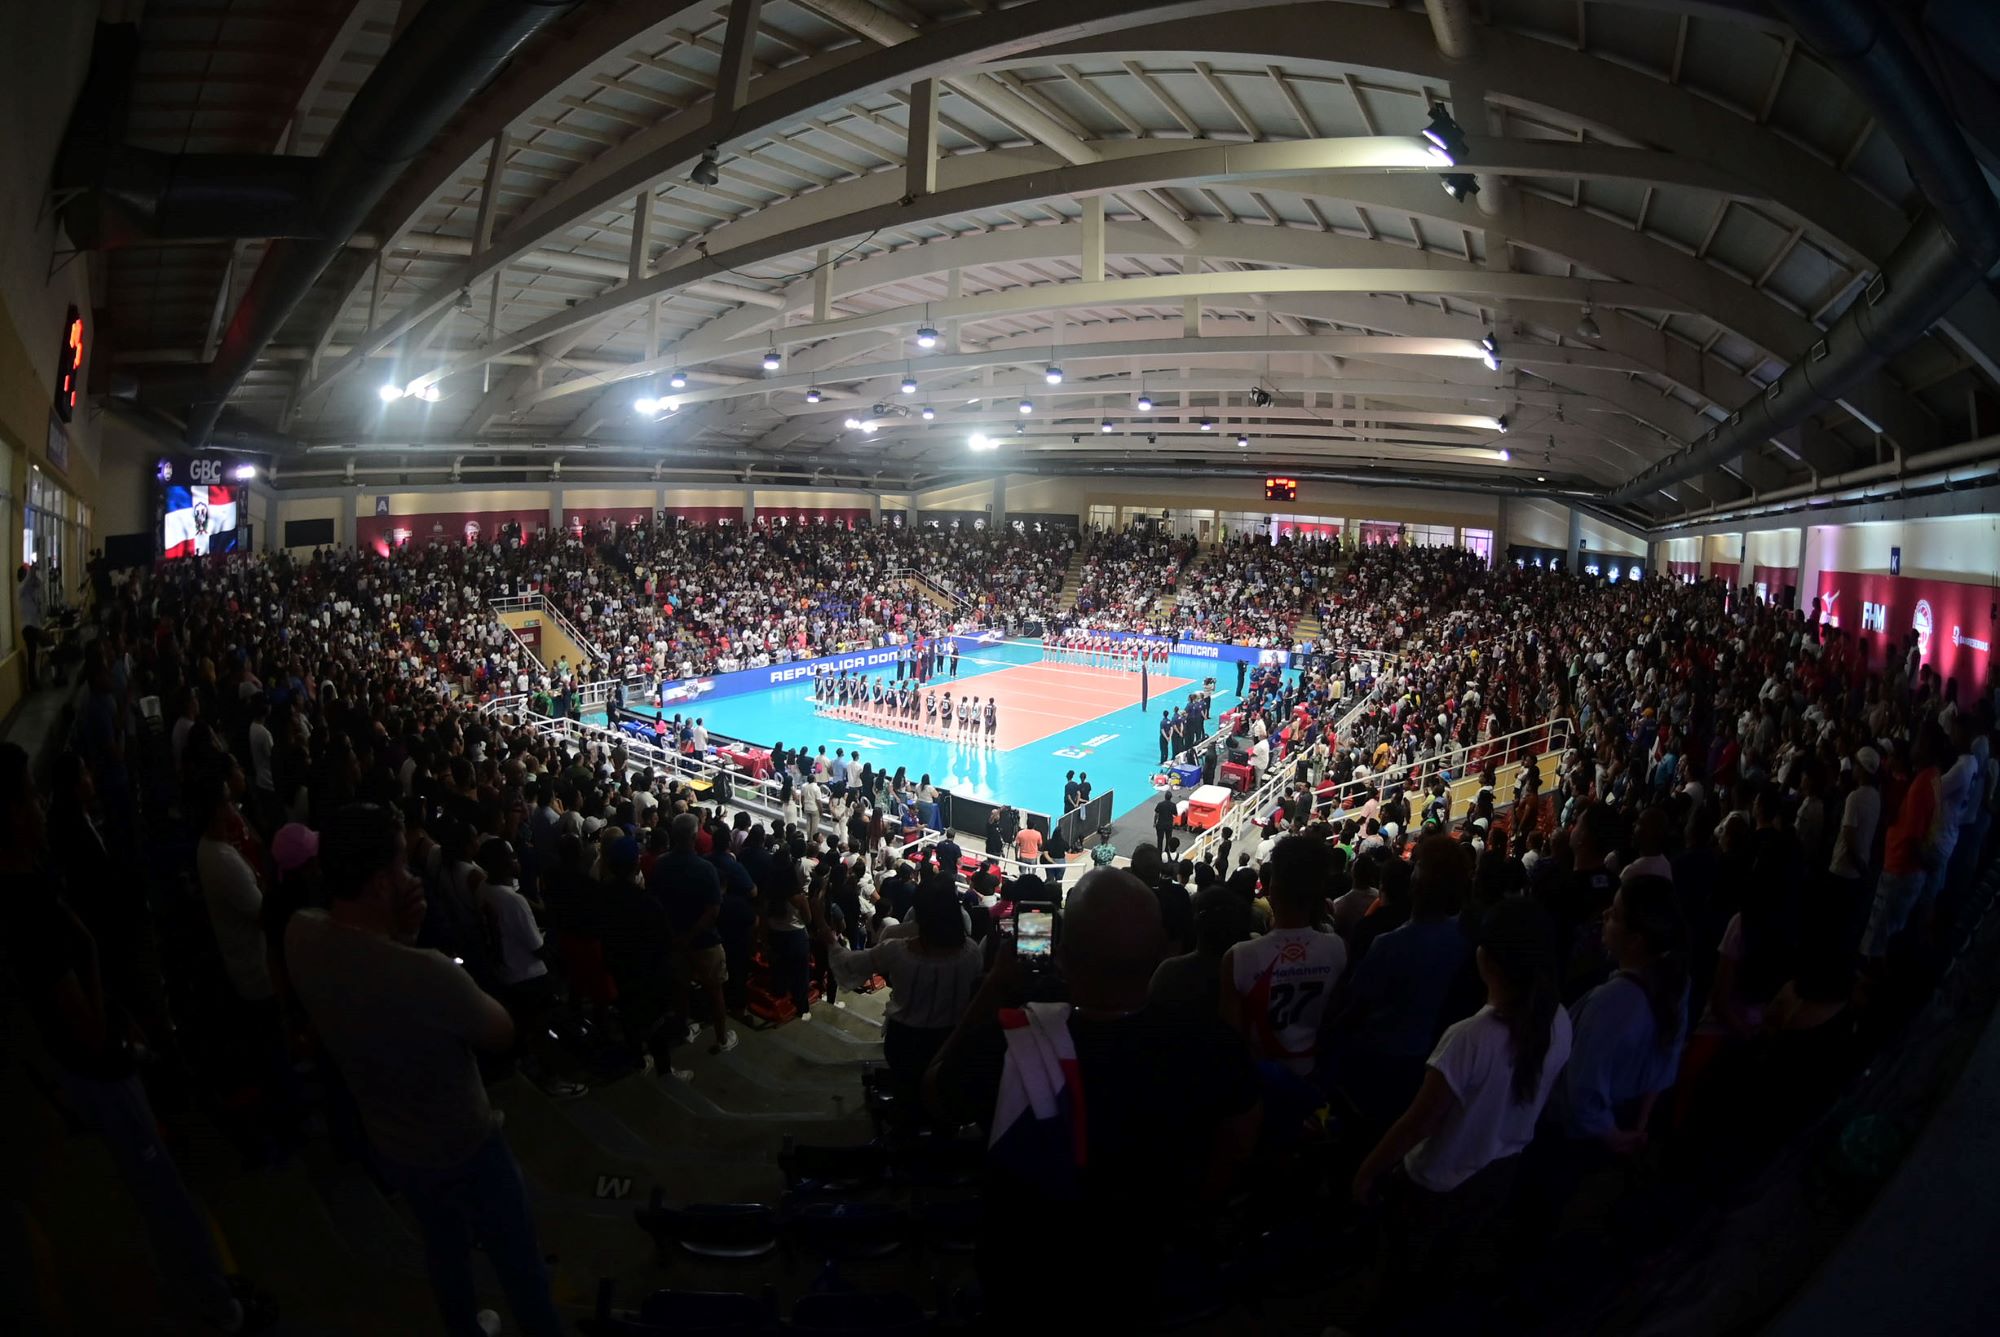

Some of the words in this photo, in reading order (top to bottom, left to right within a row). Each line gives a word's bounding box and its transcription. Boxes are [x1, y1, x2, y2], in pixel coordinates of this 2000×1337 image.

[190, 459, 222, 480] GBC
[377, 500, 388, 512] A
[1891, 555, 1898, 571] K
[1862, 601, 1886, 631] FHM
[1270, 981, 1325, 1030] 27
